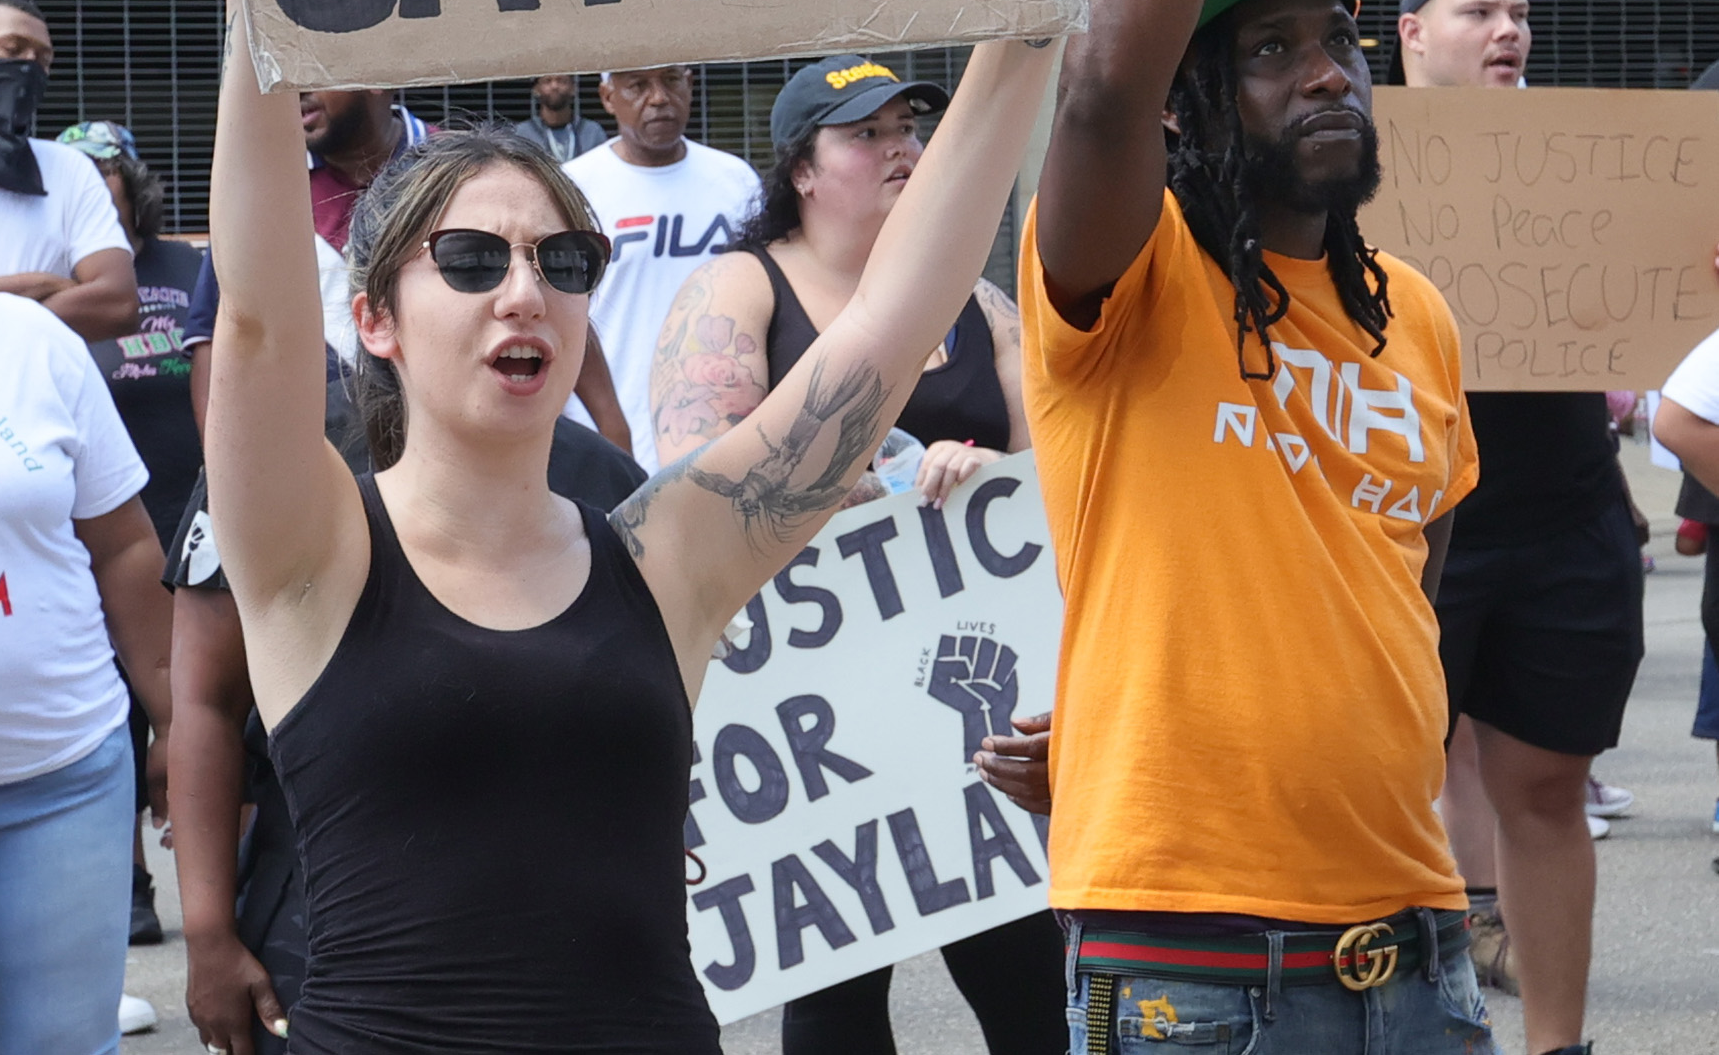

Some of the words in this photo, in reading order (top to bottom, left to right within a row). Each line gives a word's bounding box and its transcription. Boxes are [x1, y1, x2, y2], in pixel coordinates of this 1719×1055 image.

[1388, 118, 1452, 188] NO
[1476, 131, 1700, 188] JUSTICE
[611, 213, 734, 263] FILA
[1474, 332, 1631, 379] POLICE
[720, 476, 1045, 675] USTIC
[956, 620, 997, 635] LIVES
[913, 647, 932, 688] BLACK
